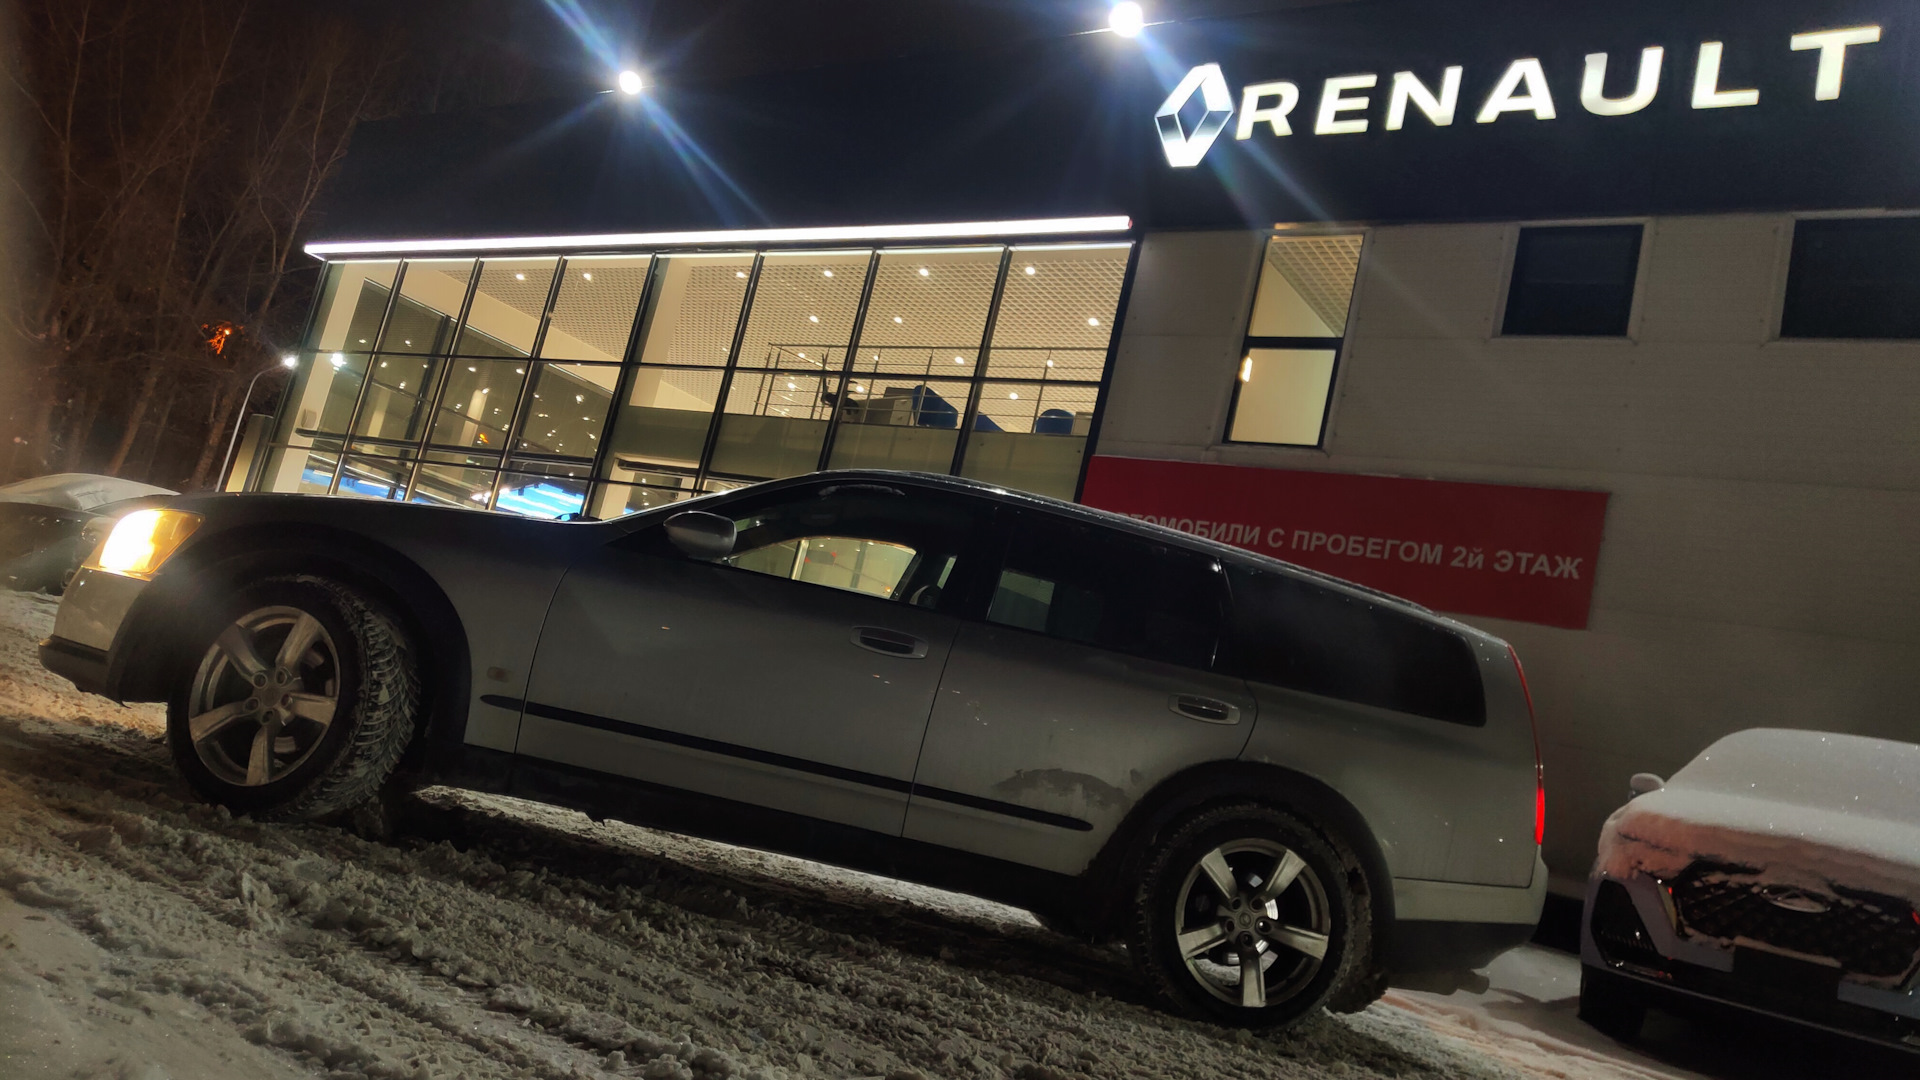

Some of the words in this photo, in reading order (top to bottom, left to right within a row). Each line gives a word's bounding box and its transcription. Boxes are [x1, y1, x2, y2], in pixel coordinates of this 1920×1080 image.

[1236, 26, 1882, 140] RENAULT
[1267, 528, 1285, 548] С
[1291, 531, 1443, 565] ПРОБЕГОМ
[1450, 546, 1484, 570] 2й
[1493, 550, 1584, 579] ЭТАЖ
